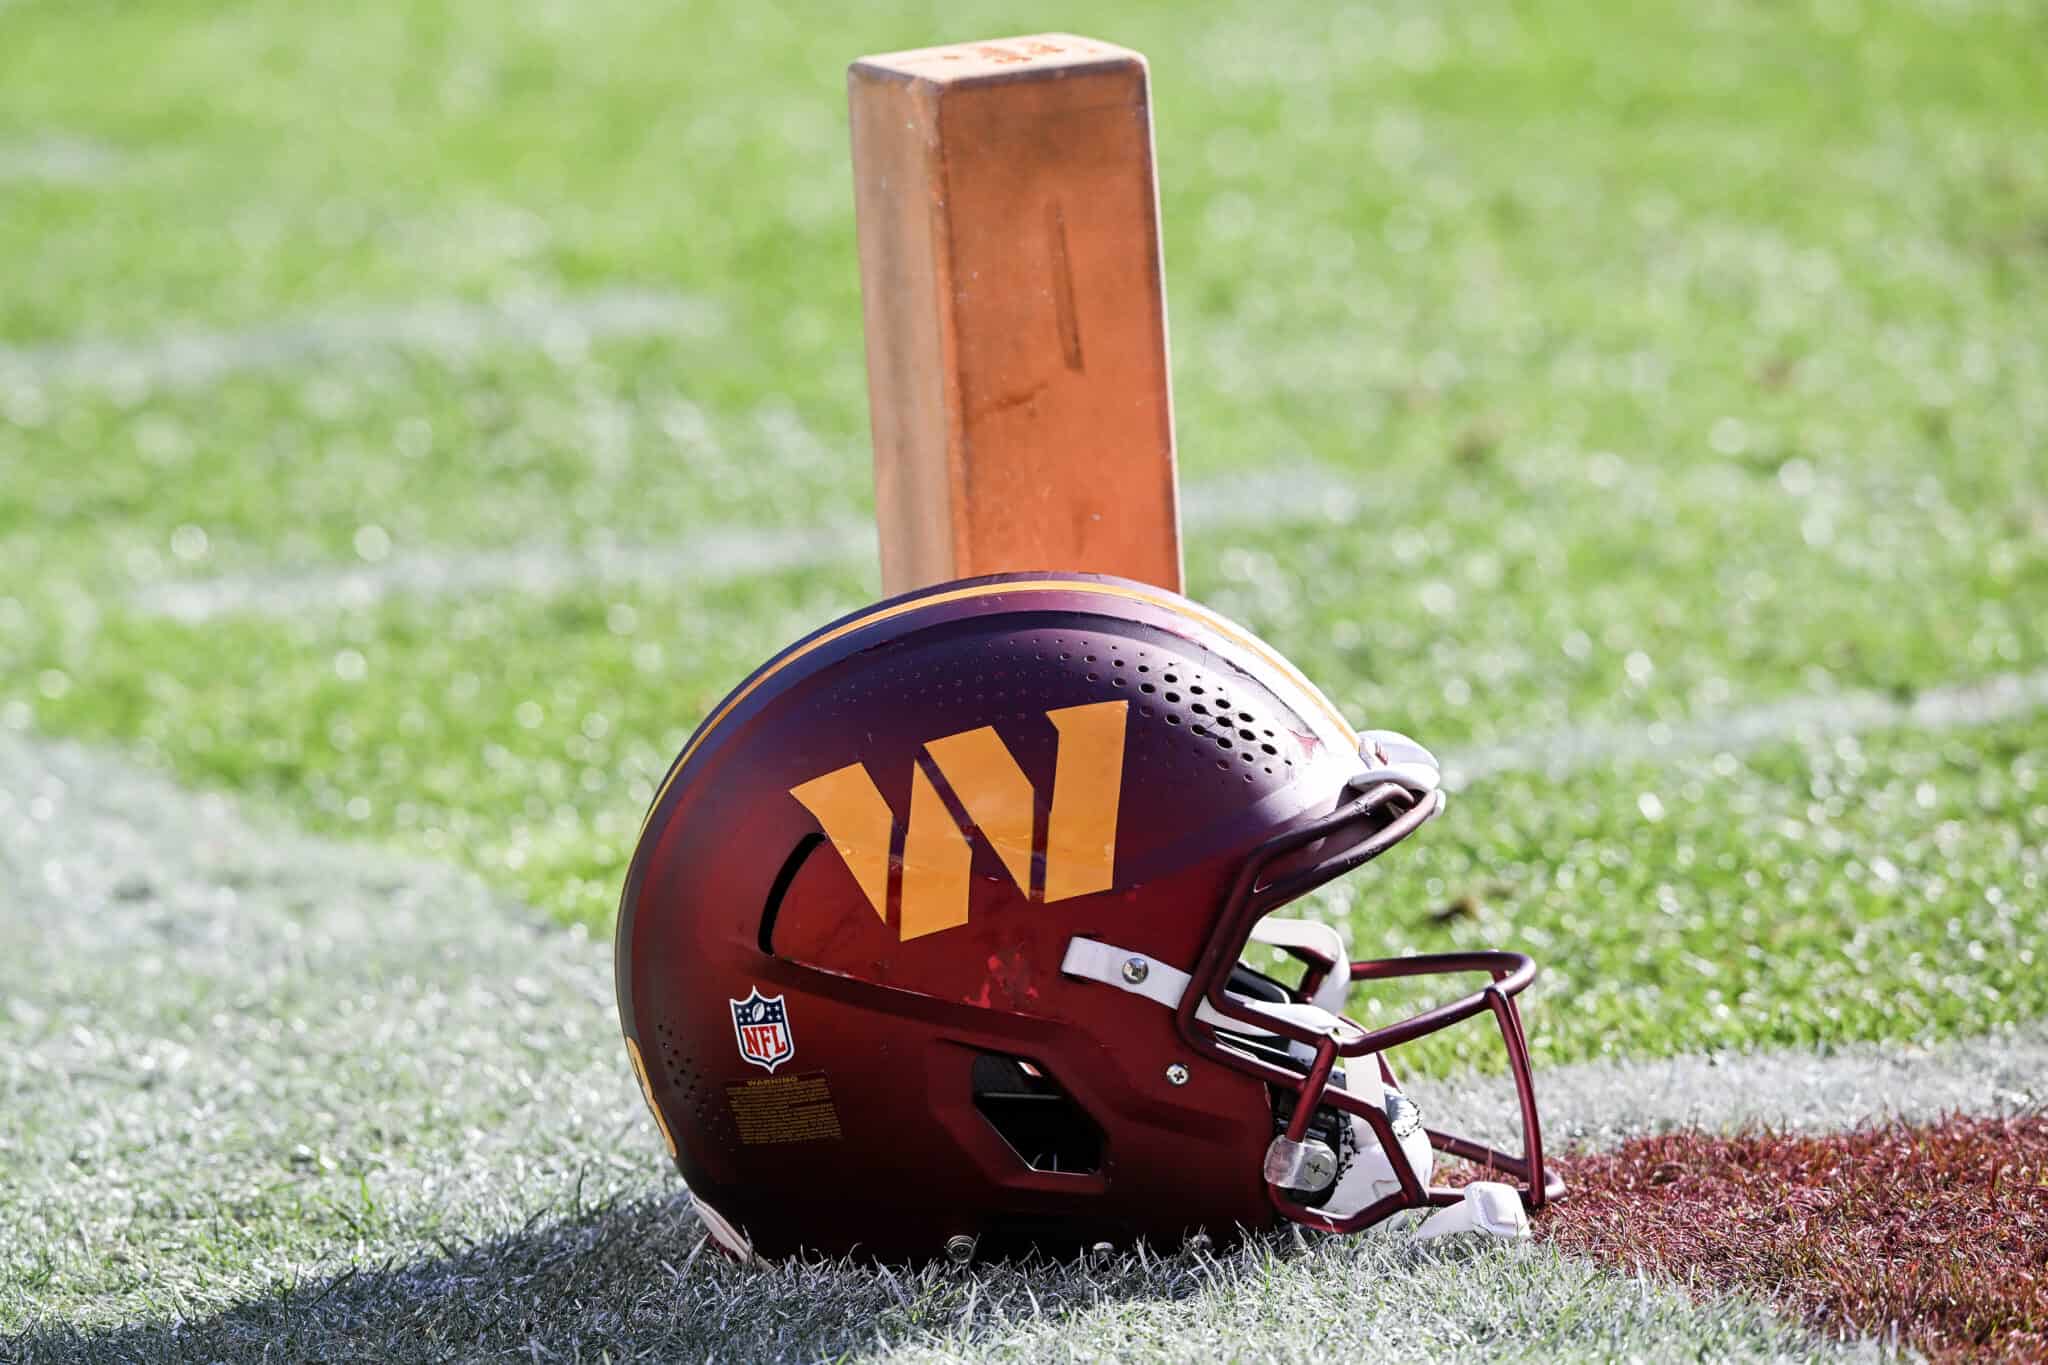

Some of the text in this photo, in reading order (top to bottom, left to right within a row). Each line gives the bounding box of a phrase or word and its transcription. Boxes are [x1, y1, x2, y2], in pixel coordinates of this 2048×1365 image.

[789, 700, 1128, 940] W
[742, 1025, 787, 1059] NFL
[746, 1075, 799, 1088] WARNING
